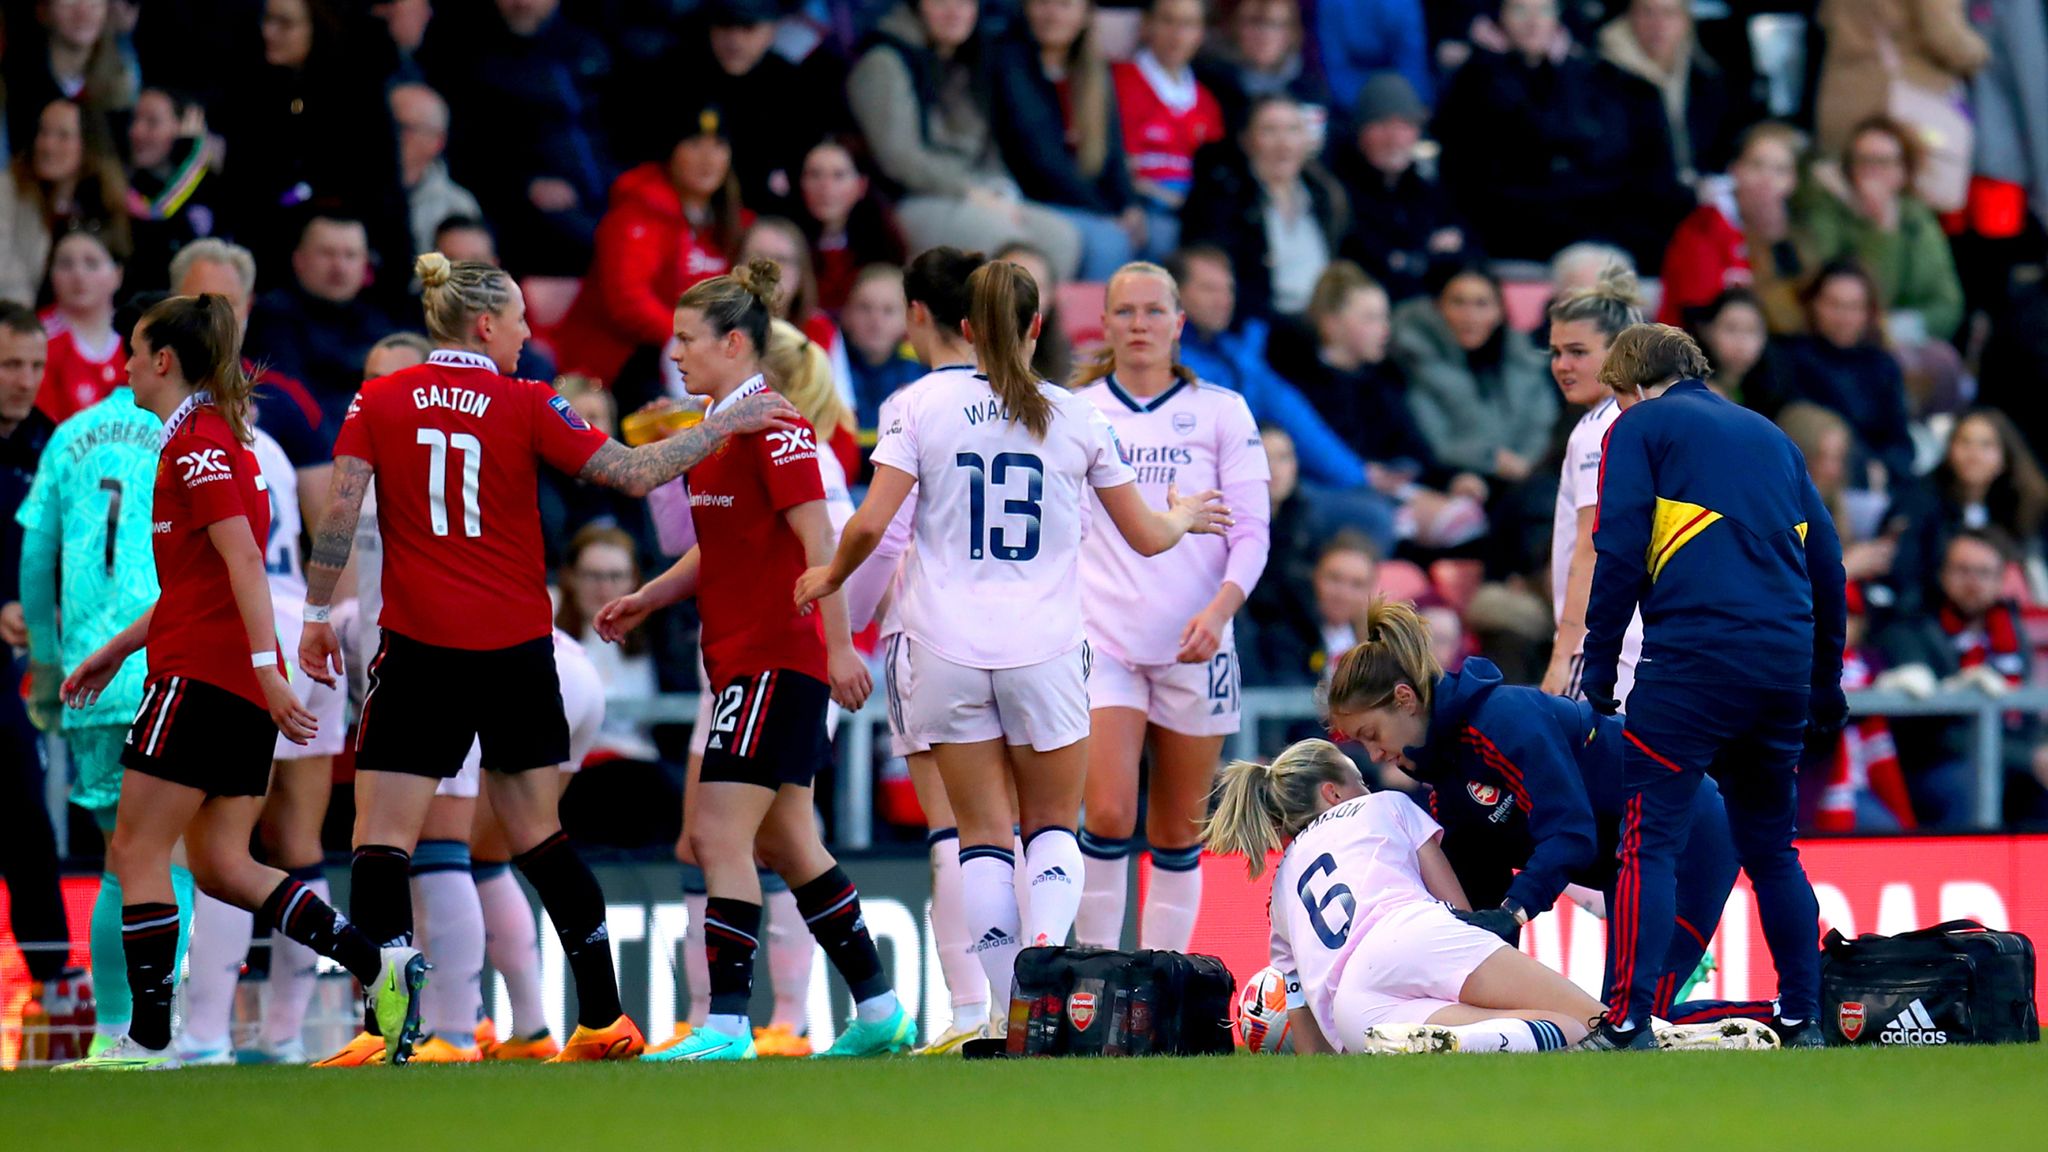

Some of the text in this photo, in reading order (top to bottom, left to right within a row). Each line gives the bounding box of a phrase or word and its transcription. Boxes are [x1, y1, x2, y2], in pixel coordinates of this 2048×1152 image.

[413, 385, 491, 418] GALTON
[417, 428, 481, 537] 11
[956, 452, 1043, 561] 13
[99, 477, 123, 577] 1
[711, 685, 744, 732] 12
[1208, 653, 1229, 699] 12
[1297, 852, 1356, 950] 6
[1880, 1028, 1947, 1045] adidas
